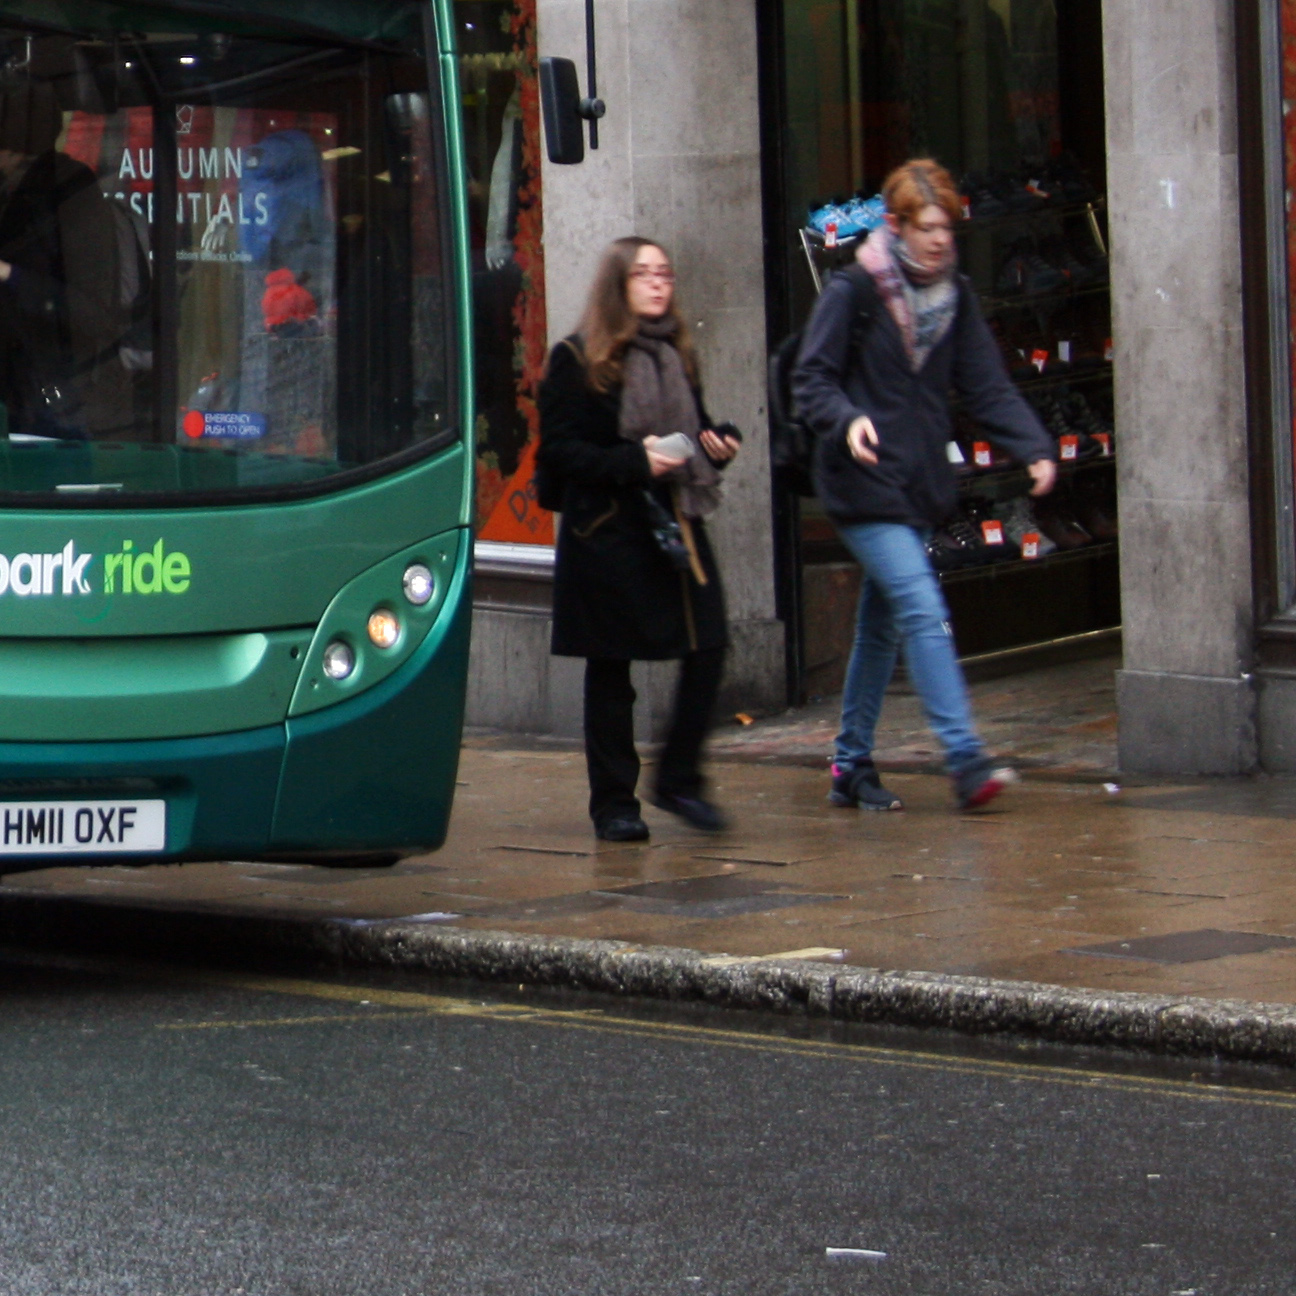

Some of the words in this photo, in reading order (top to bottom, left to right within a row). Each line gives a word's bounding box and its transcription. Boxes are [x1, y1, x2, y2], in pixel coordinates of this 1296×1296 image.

[118, 147, 243, 180] AUUMN
[103, 537, 192, 595] ride
[3, 808, 64, 845] HM11
[74, 806, 138, 844] OXF
